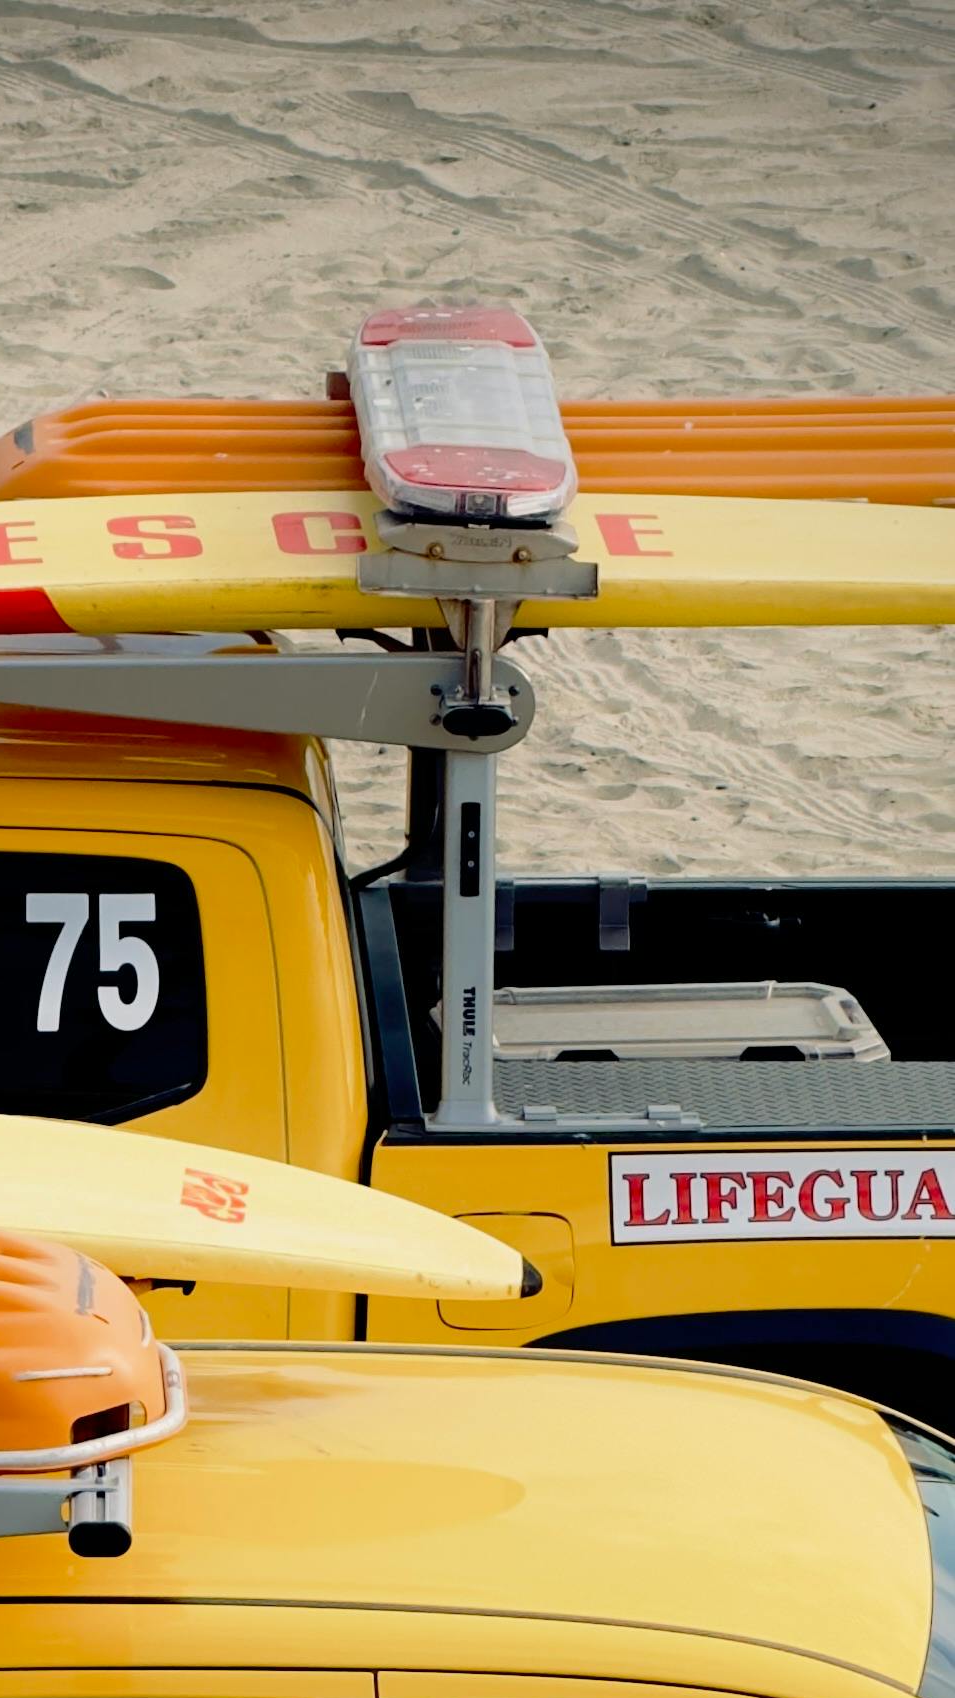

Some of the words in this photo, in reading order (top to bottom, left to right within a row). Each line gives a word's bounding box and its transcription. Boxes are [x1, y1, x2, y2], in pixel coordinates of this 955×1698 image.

[26, 893, 160, 1032] 75
[462, 986, 476, 1036] THULE
[622, 1168, 955, 1227] LIFEGUA
